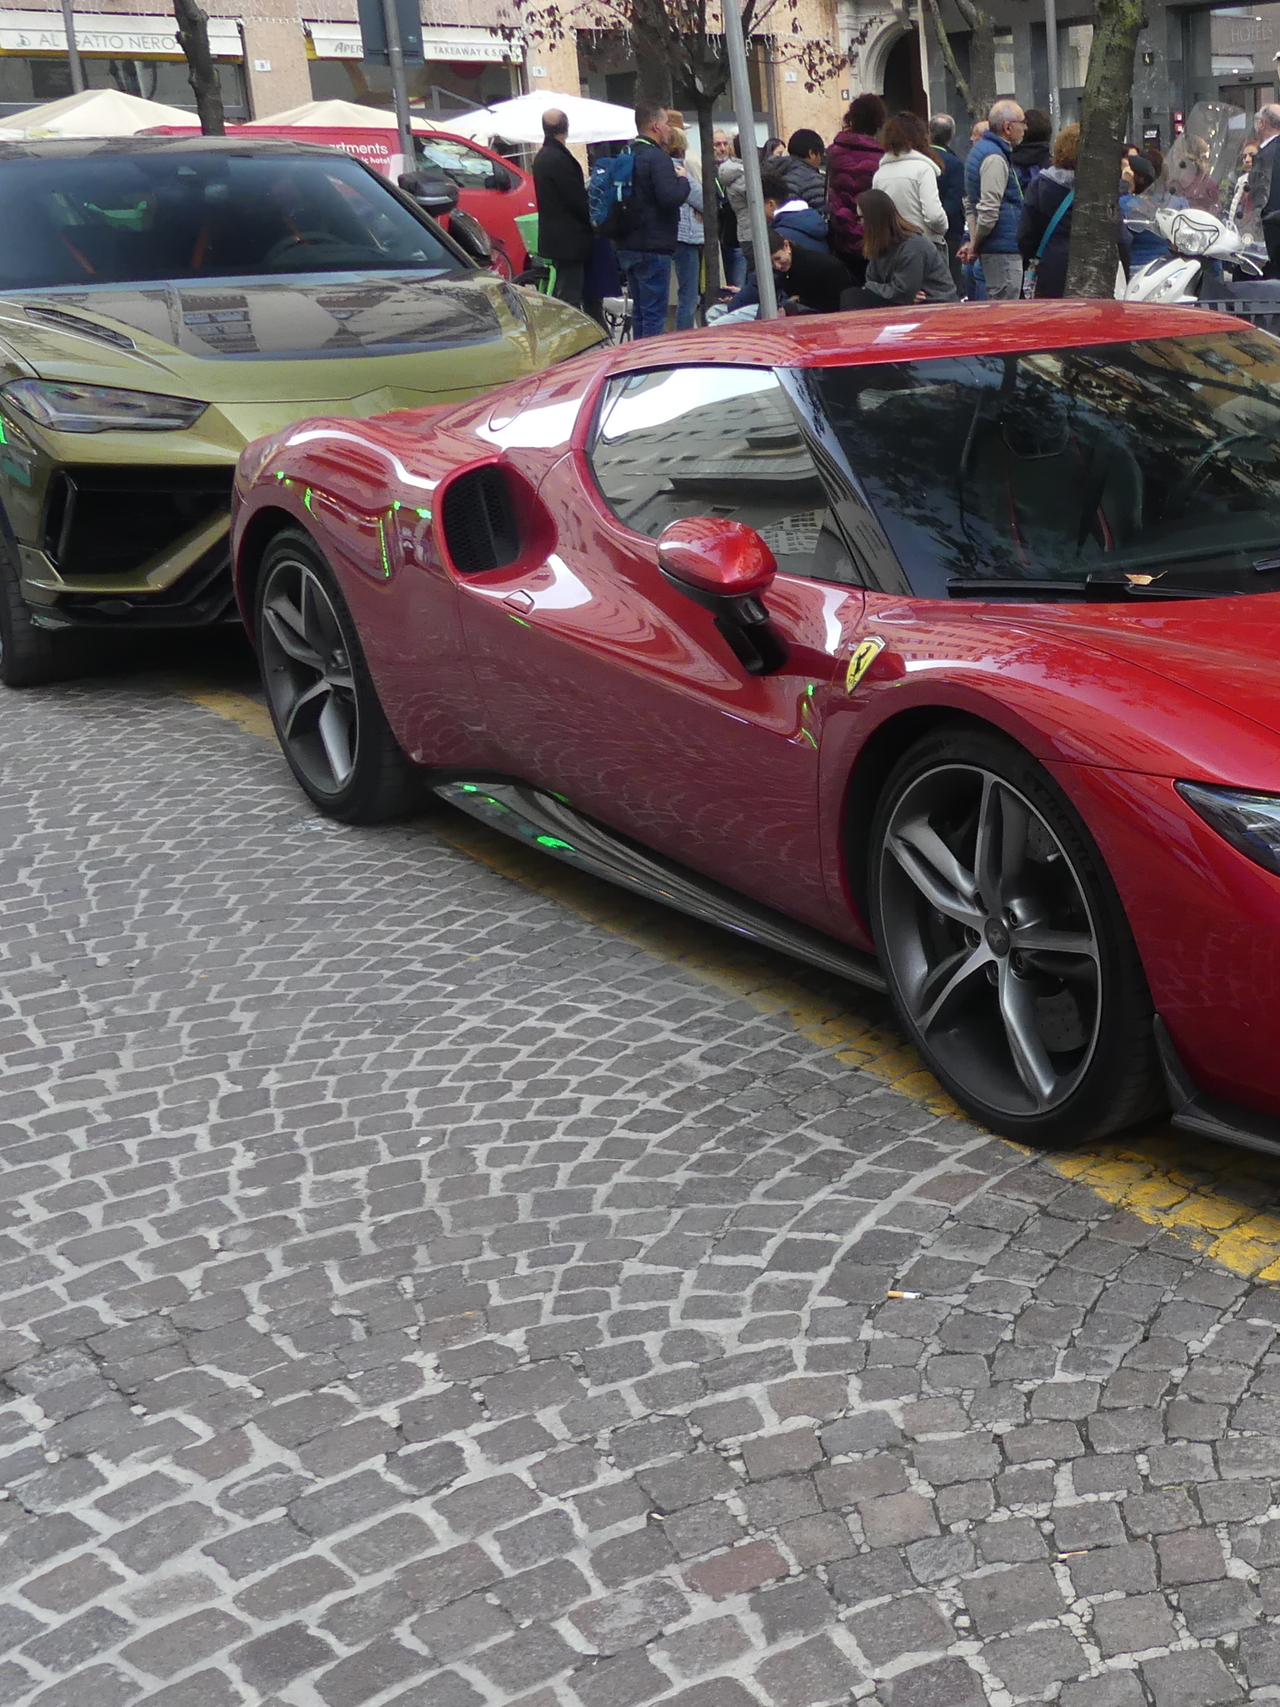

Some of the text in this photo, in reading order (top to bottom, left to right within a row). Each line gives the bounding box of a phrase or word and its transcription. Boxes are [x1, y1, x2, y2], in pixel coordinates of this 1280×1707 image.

[39, 33, 60, 47] AL
[128, 36, 176, 50] NERO
[434, 46, 481, 57] TAKEAWAY
[842, 90, 849, 100] 6
